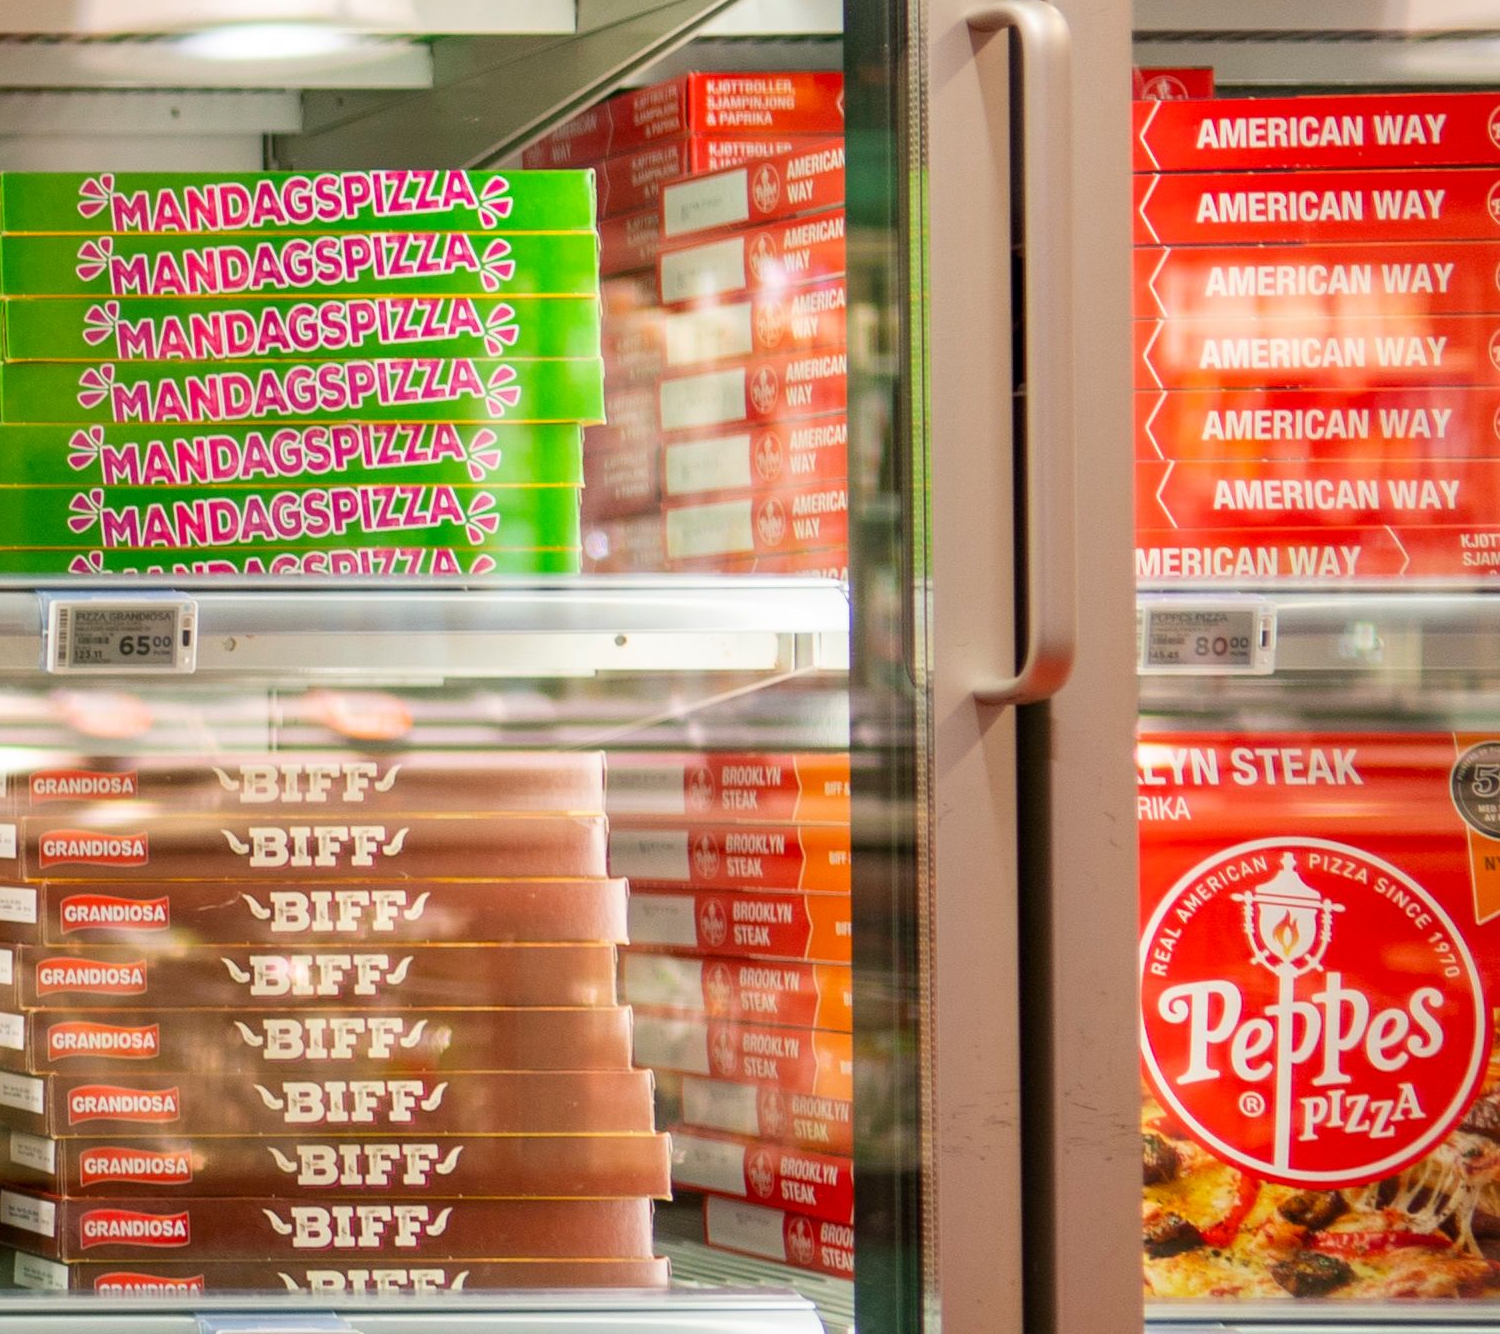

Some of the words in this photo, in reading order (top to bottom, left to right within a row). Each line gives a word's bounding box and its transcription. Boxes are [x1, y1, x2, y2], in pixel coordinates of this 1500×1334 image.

[707, 111, 716, 125] &
[719, 111, 773, 125] PAPRIKA
[1196, 116, 1364, 149] AMERICAN
[1373, 114, 1447, 146] WAY
[111, 170, 479, 231] MANDAGSPIZZA
[1232, 747, 1364, 787] STEAK
[64, 903, 167, 924] GRANDIOSA
[269, 891, 409, 933] BIFF
[733, 901, 793, 923] BROOKLYN
[1151, 936, 1176, 977] REAL
[1175, 854, 1269, 935] AMERICAN
[1307, 852, 1370, 883] PIZZA
[1374, 875, 1435, 931] SINCE
[1428, 928, 1462, 980] 1970
[734, 926, 770, 946] STEAK
[1157, 971, 1445, 1086] Peppes
[1300, 1083, 1426, 1141] PIZZA
